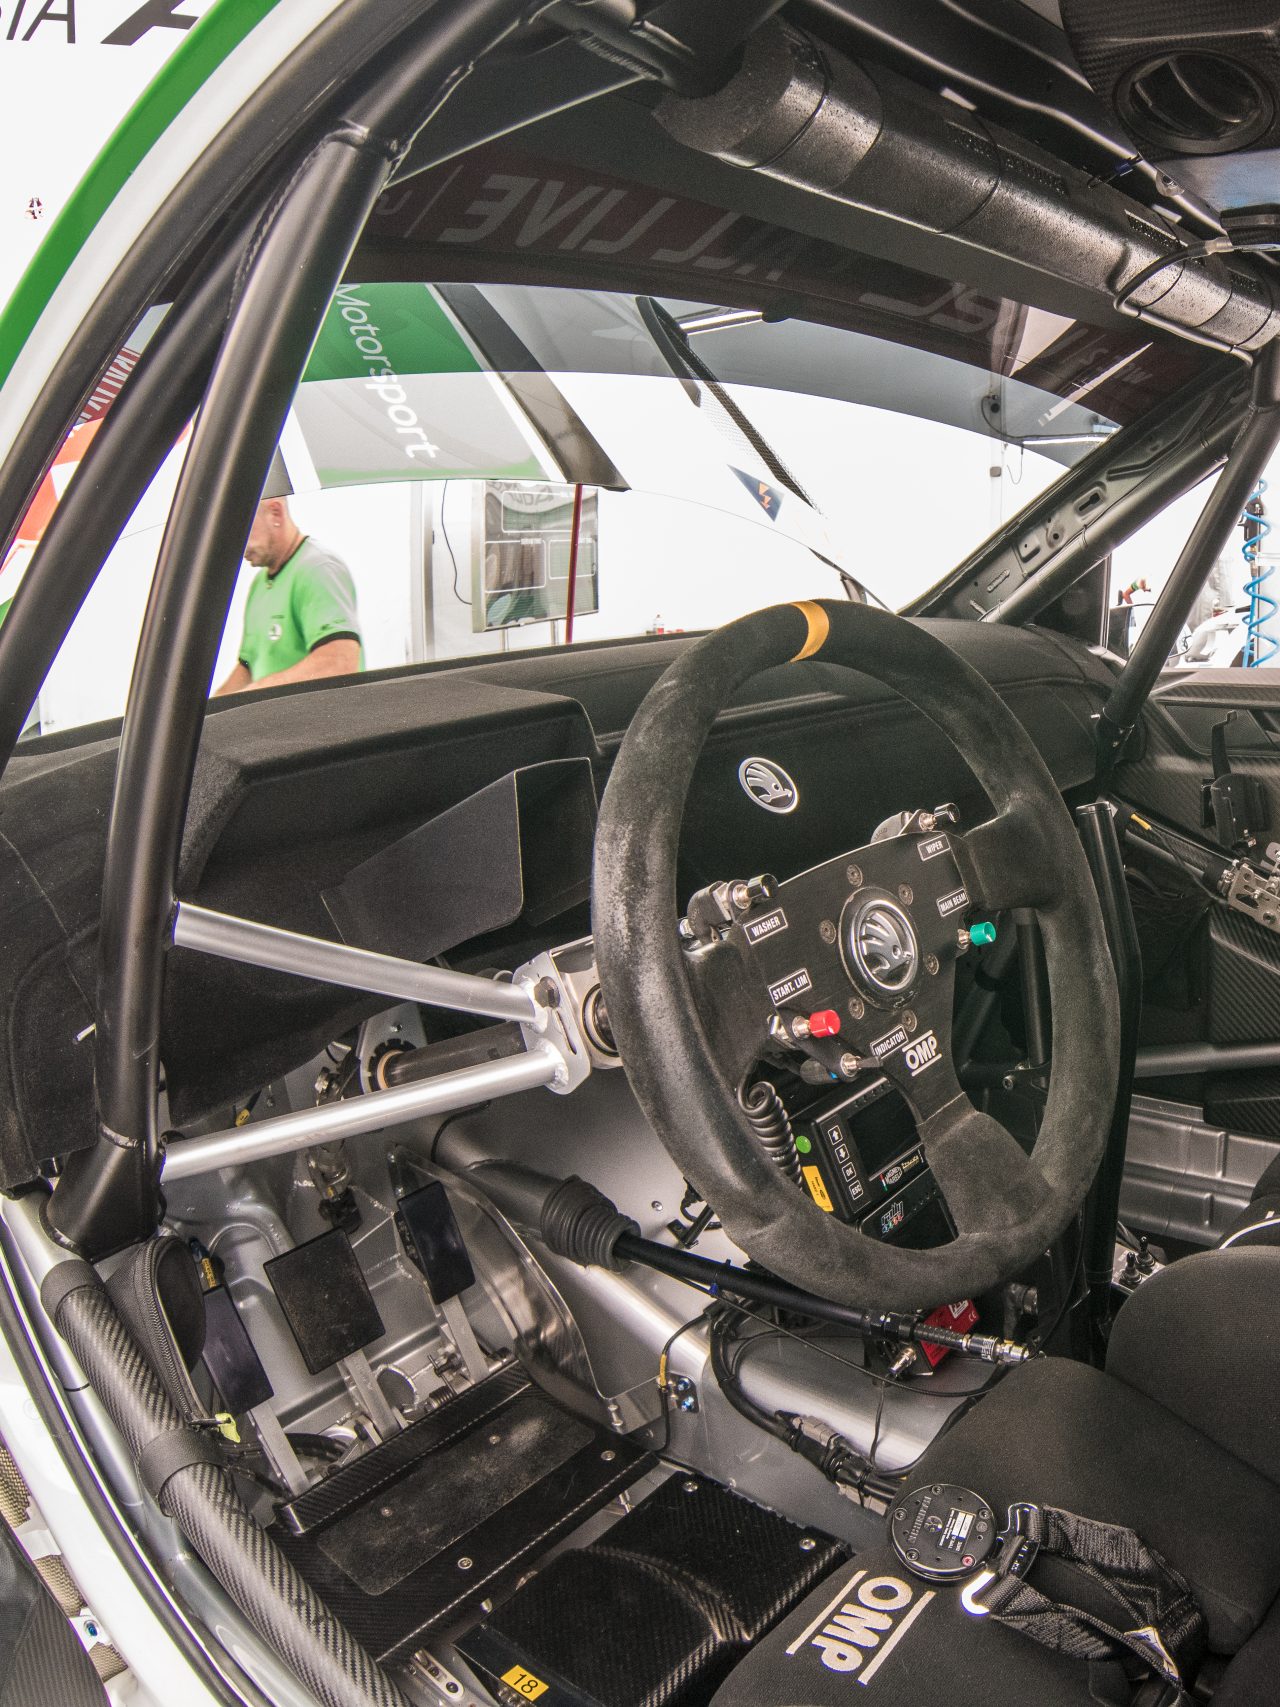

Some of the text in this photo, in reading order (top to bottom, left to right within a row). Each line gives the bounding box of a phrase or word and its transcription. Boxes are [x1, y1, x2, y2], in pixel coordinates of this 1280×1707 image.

[334, 284, 440, 459] Motorsport
[925, 840, 944, 854] WIPER
[939, 892, 967, 912] MAIN BEAM
[751, 916, 781, 938] WASHER
[772, 974, 809, 1001] START. LIM
[874, 1030, 906, 1056] INDICATOR
[905, 1035, 938, 1070] OMP
[851, 1184, 862, 1196] ESC
[811, 1576, 913, 1673] OMP
[513, 1673, 539, 1694] 18
